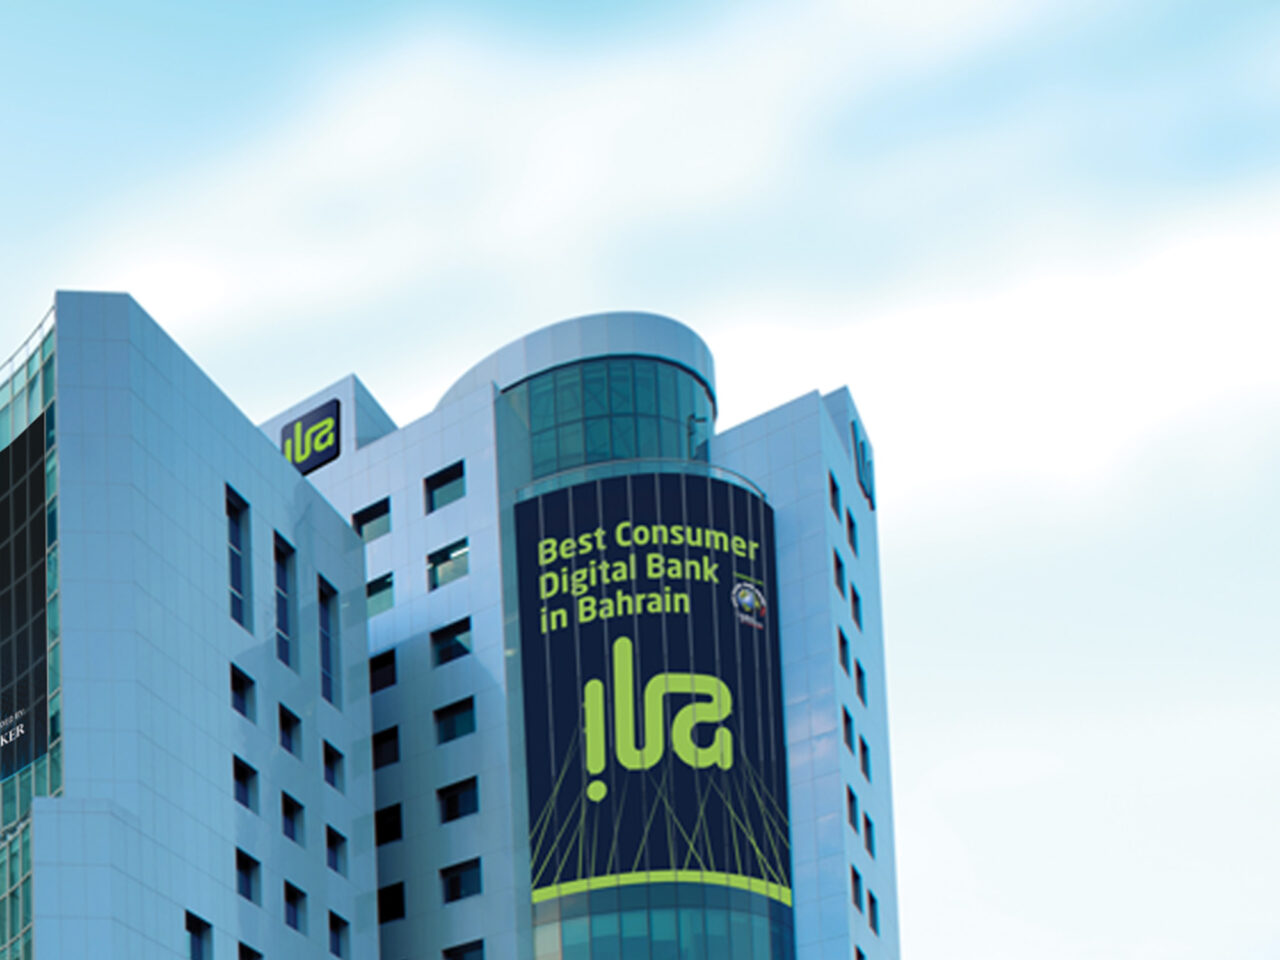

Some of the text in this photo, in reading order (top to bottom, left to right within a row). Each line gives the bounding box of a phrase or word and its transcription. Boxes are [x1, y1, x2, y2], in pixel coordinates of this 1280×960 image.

[538, 521, 760, 567] Best Consumer
[539, 553, 719, 600] Digital Bank
[540, 586, 690, 635] in Bahrain
